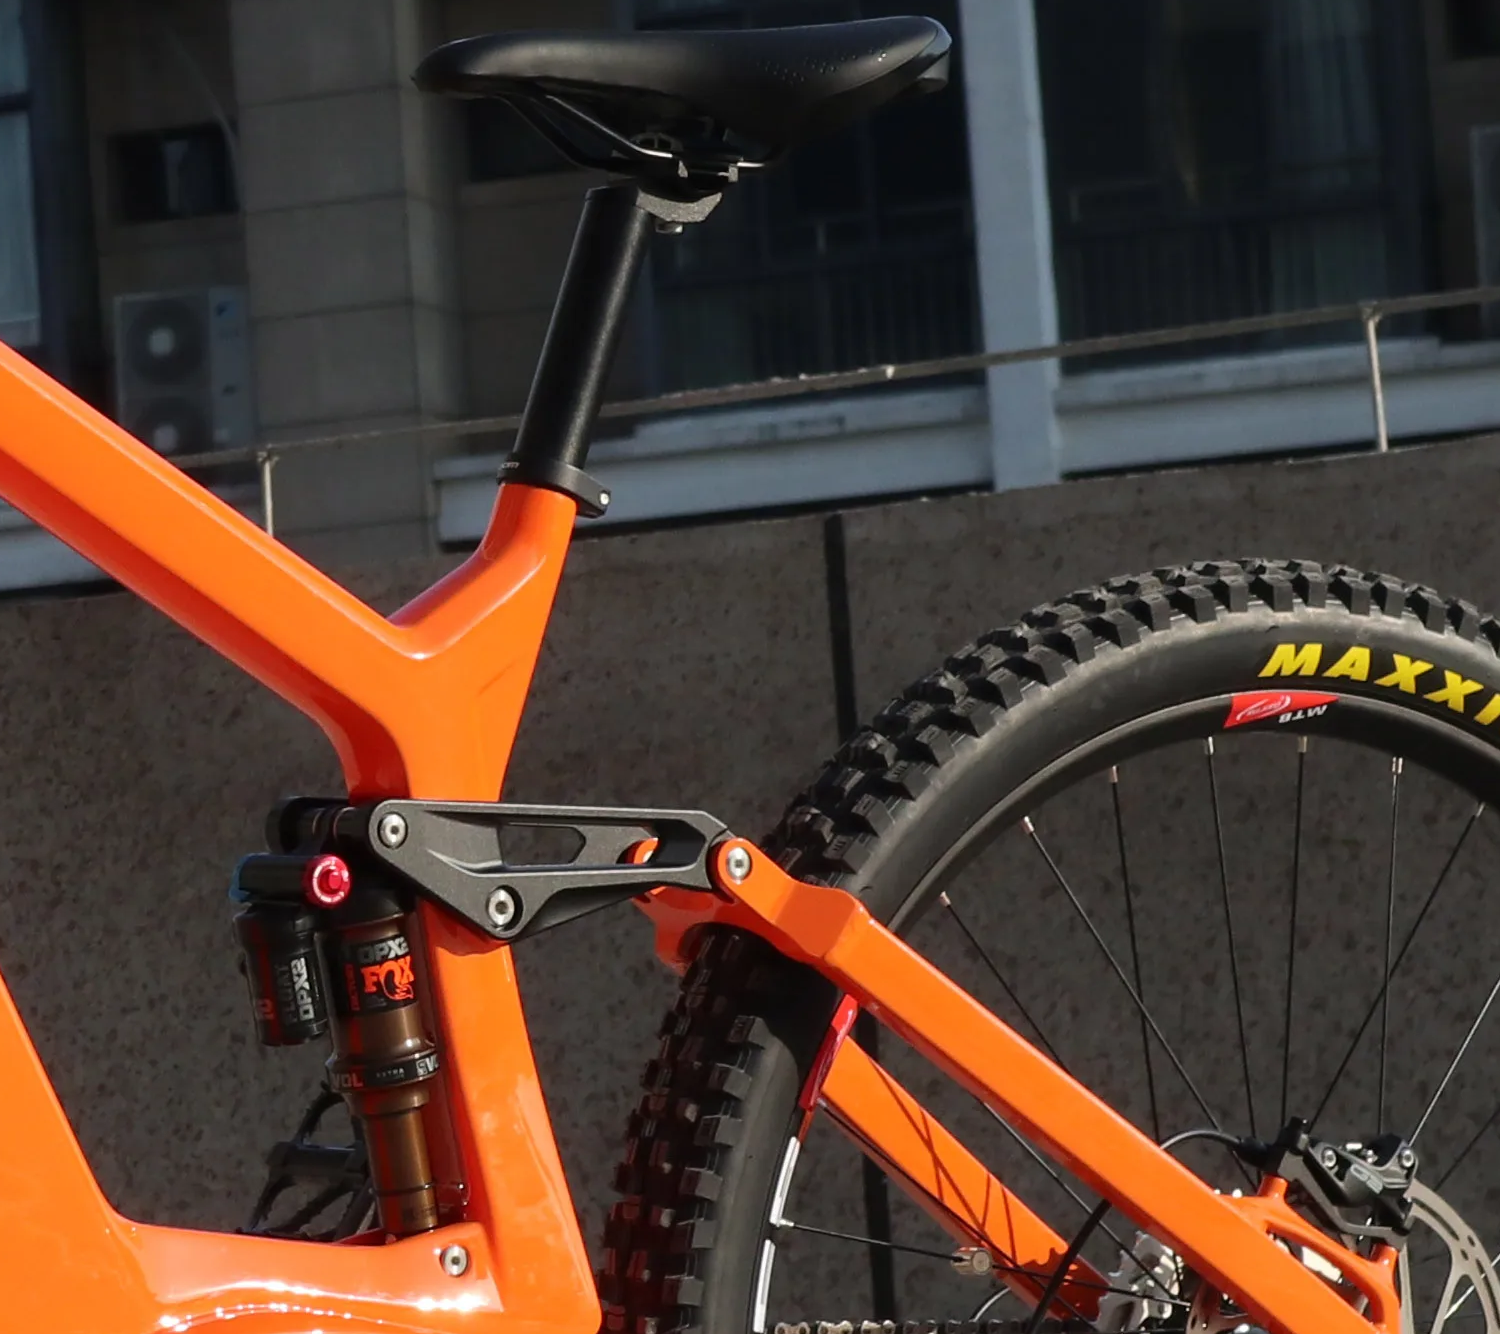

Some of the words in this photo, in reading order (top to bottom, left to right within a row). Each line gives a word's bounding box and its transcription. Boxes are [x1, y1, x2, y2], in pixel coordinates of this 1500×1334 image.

[1279, 704, 1328, 723] MTB
[290, 957, 316, 1022] DPX2
[360, 956, 415, 1002] FOX
